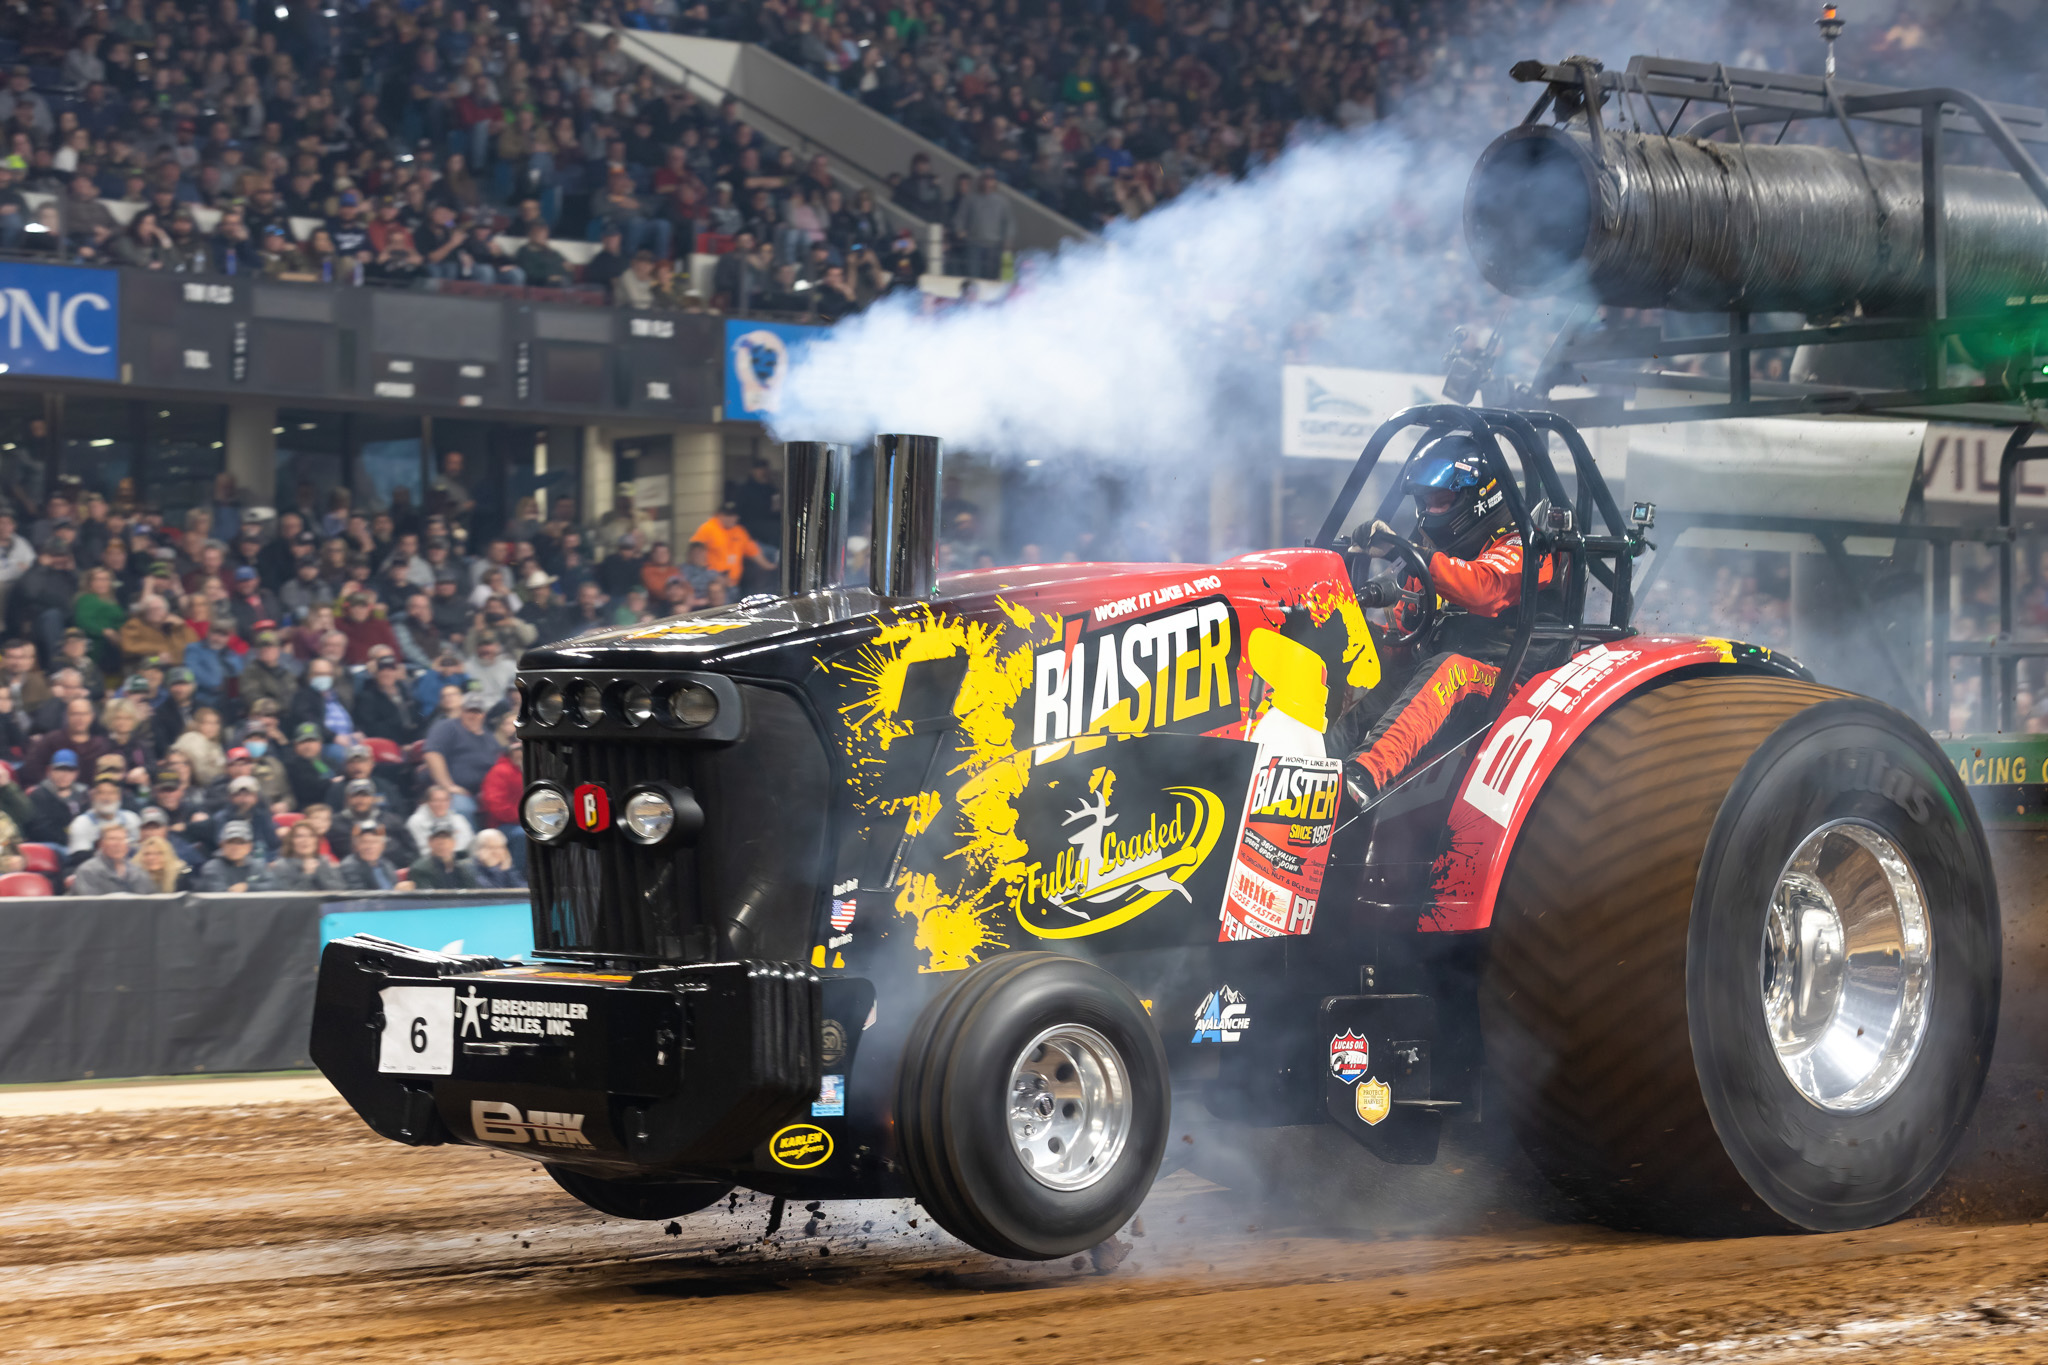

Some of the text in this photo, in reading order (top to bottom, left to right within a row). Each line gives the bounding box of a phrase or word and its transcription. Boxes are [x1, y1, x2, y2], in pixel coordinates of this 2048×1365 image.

[1094, 575, 1222, 622] WORK IT LIKE A PRO
[1563, 666, 1614, 715] SCALES
[1951, 756, 2026, 784] ACING
[1289, 823, 1332, 844] SINCE 1957
[1025, 802, 1185, 904] Fully Loaded
[1277, 850, 1298, 864] VALVE
[1271, 870, 1286, 882] NUT
[1280, 860, 1300, 872] DOWN
[1251, 901, 1282, 925] FASTER
[491, 998, 588, 1020] BRECHBUHLER
[410, 1016, 428, 1053] 6
[490, 1015, 575, 1038] SCALES, INC.
[1194, 1016, 1250, 1034] AVALANCHE
[1333, 1040, 1365, 1050] LUCAS OIL
[779, 1132, 823, 1149] KARLEN
